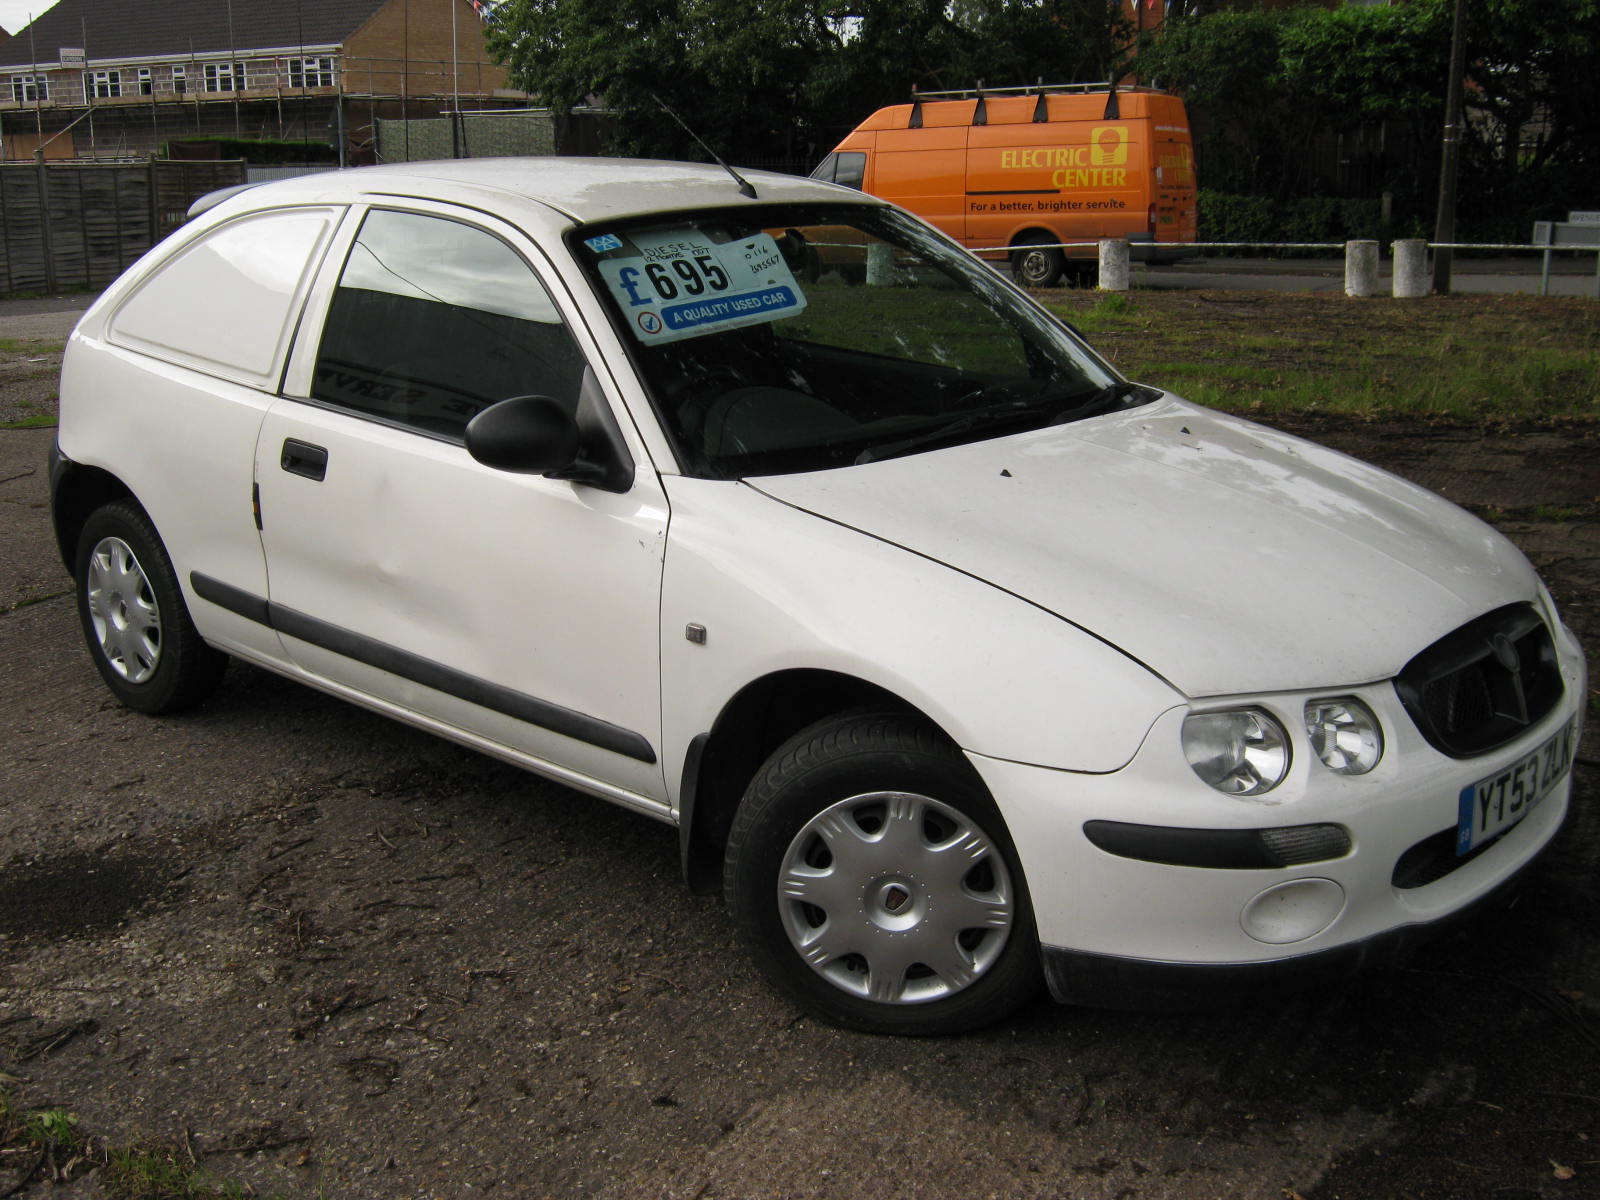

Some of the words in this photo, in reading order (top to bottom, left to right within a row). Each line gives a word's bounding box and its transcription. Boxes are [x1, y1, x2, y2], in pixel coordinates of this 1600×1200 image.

[1001, 147, 1089, 169] ELECTRIC
[1052, 167, 1127, 188] CENTER
[970, 202, 988, 212] For
[999, 201, 1035, 212] better,
[1037, 200, 1083, 213] brighter
[1086, 199, 1126, 210] service
[643, 242, 702, 257] DIESEL
[673, 310, 682, 323] A
[683, 300, 730, 321] QUALITY
[732, 295, 761, 311] USED
[763, 291, 787, 306] CAR
[1479, 754, 1539, 832] YT53
